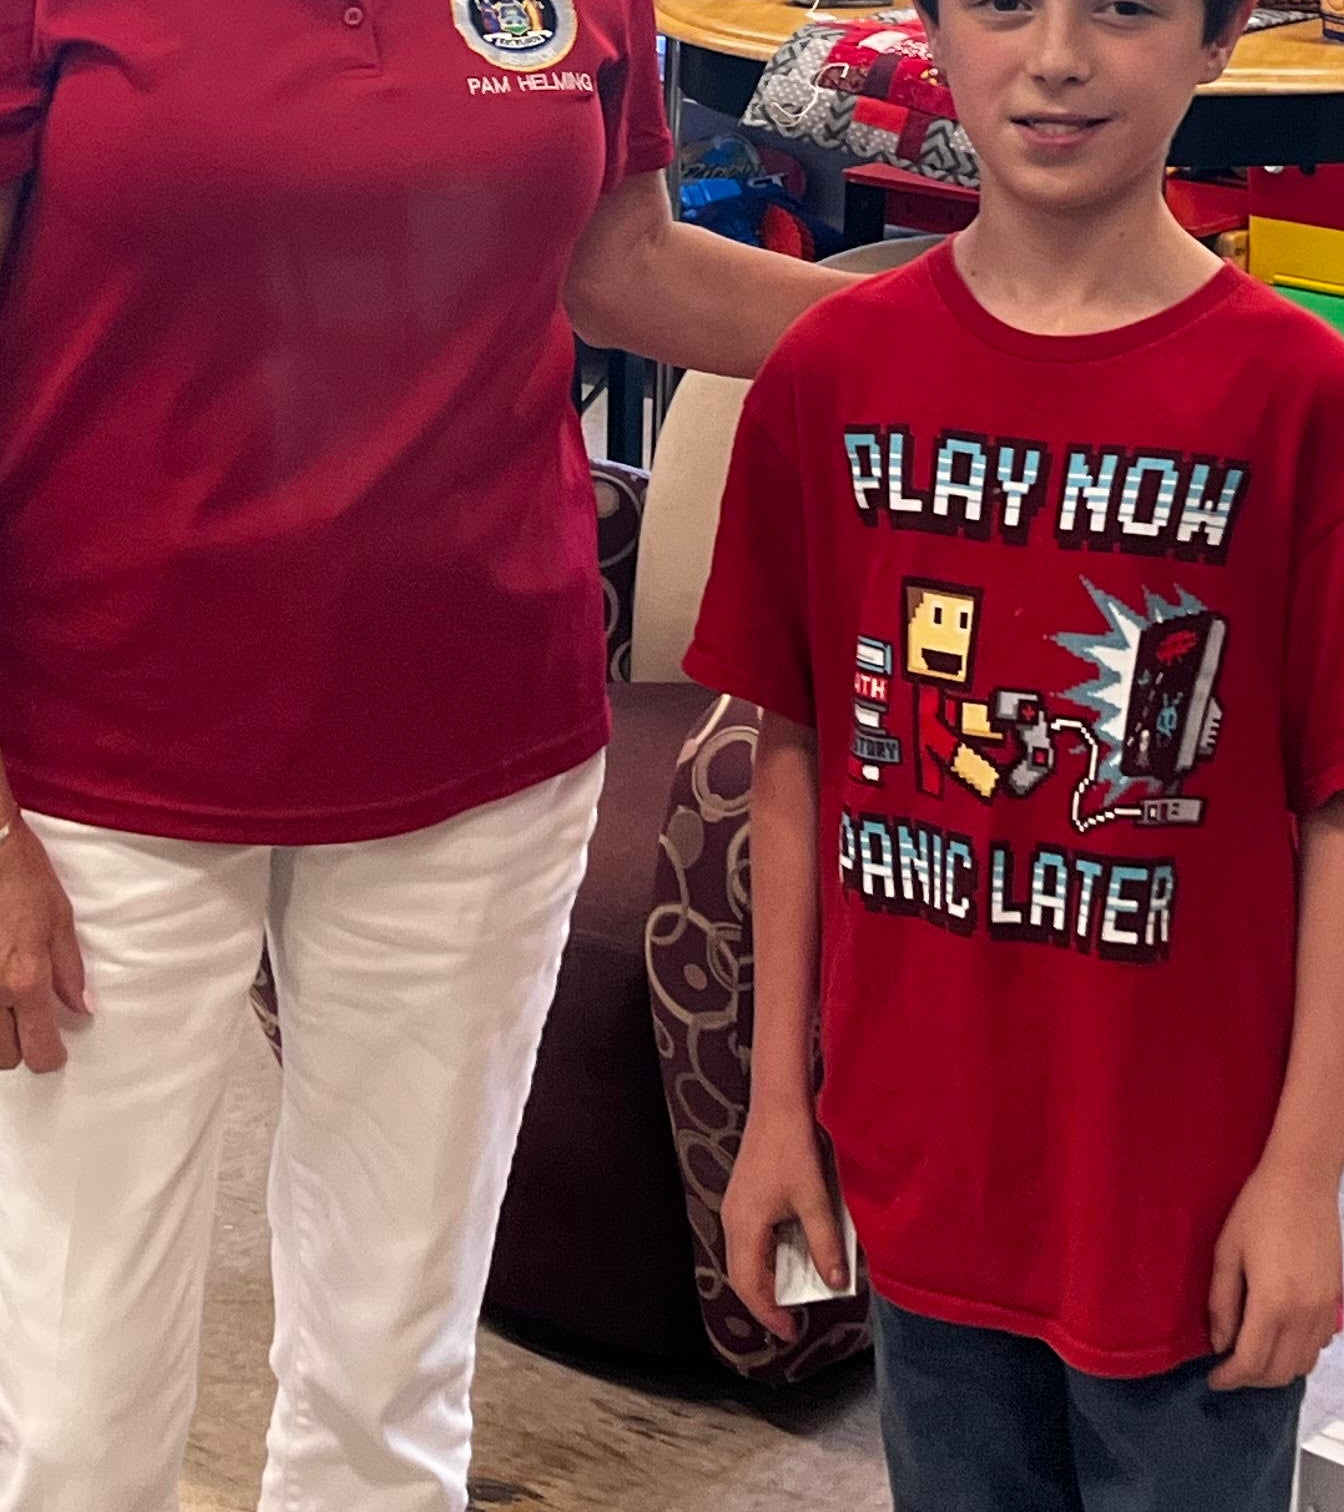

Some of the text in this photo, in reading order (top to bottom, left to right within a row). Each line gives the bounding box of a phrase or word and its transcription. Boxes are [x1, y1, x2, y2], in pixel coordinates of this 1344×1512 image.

[466, 70, 595, 96] PAM HELMING
[843, 431, 1246, 548] PLAY NOW
[839, 810, 1174, 946] PANIC LATER
